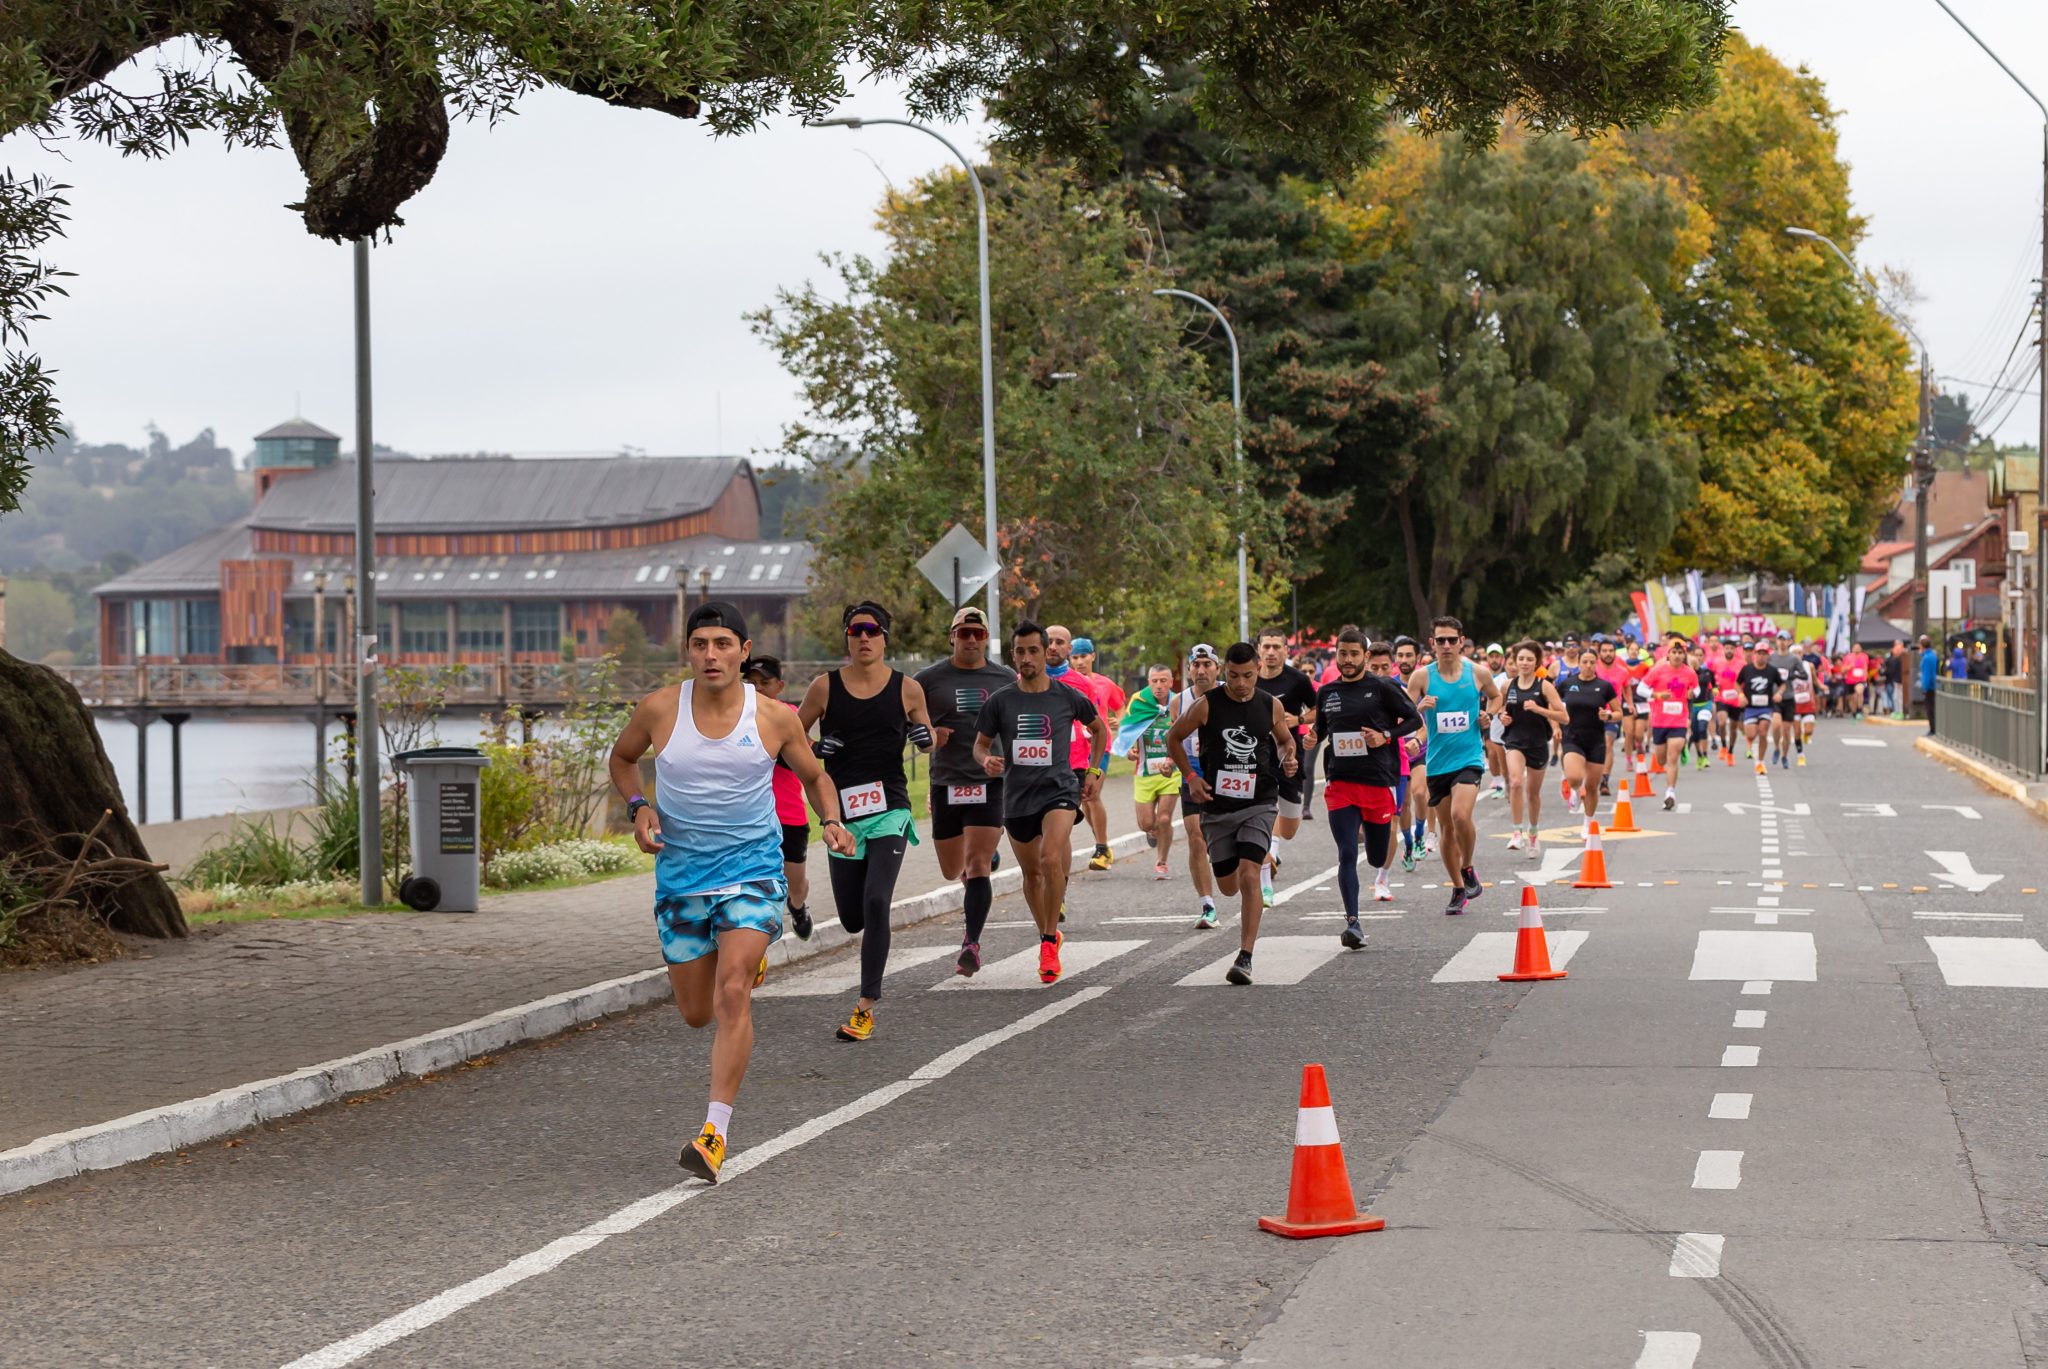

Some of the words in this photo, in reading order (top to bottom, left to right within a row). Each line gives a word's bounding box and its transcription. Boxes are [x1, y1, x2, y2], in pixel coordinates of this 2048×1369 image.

[1719, 616, 1778, 635] META
[1442, 716, 1467, 728] 112
[1338, 738, 1363, 750] 310
[1018, 746, 1049, 759] 206
[953, 785, 983, 797] 283
[1221, 777, 1250, 792] 231
[847, 790, 882, 810] 279
